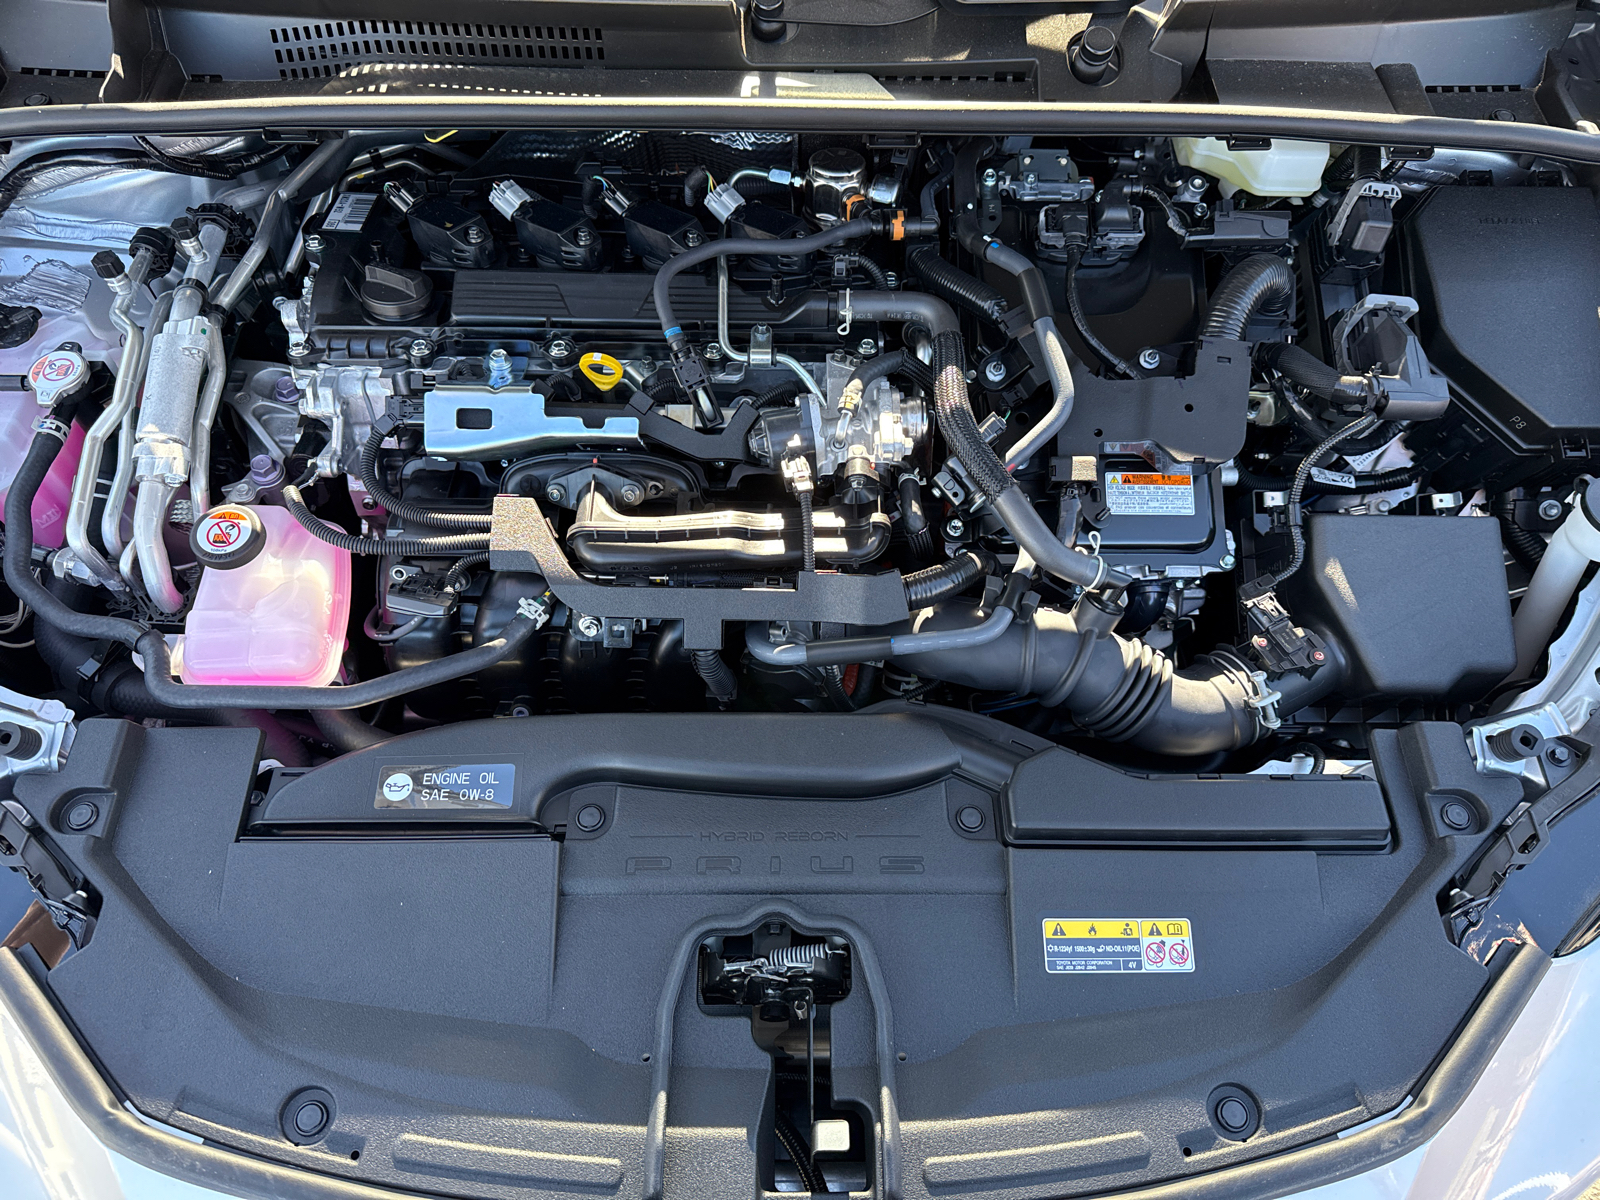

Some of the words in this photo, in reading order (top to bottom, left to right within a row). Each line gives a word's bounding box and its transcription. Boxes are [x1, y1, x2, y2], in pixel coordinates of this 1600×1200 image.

[422, 772, 471, 785] ENGINE
[479, 772, 500, 784] OIL
[420, 789, 450, 801] SAE
[459, 788, 495, 801] 0W-8
[700, 831, 765, 842] HYBRID
[775, 831, 848, 842] REBORN
[624, 855, 926, 875] PRIUS
[1053, 945, 1072, 954] R-1234yf
[1074, 945, 1096, 954] 1500±30g
[1128, 961, 1137, 969] 4V
